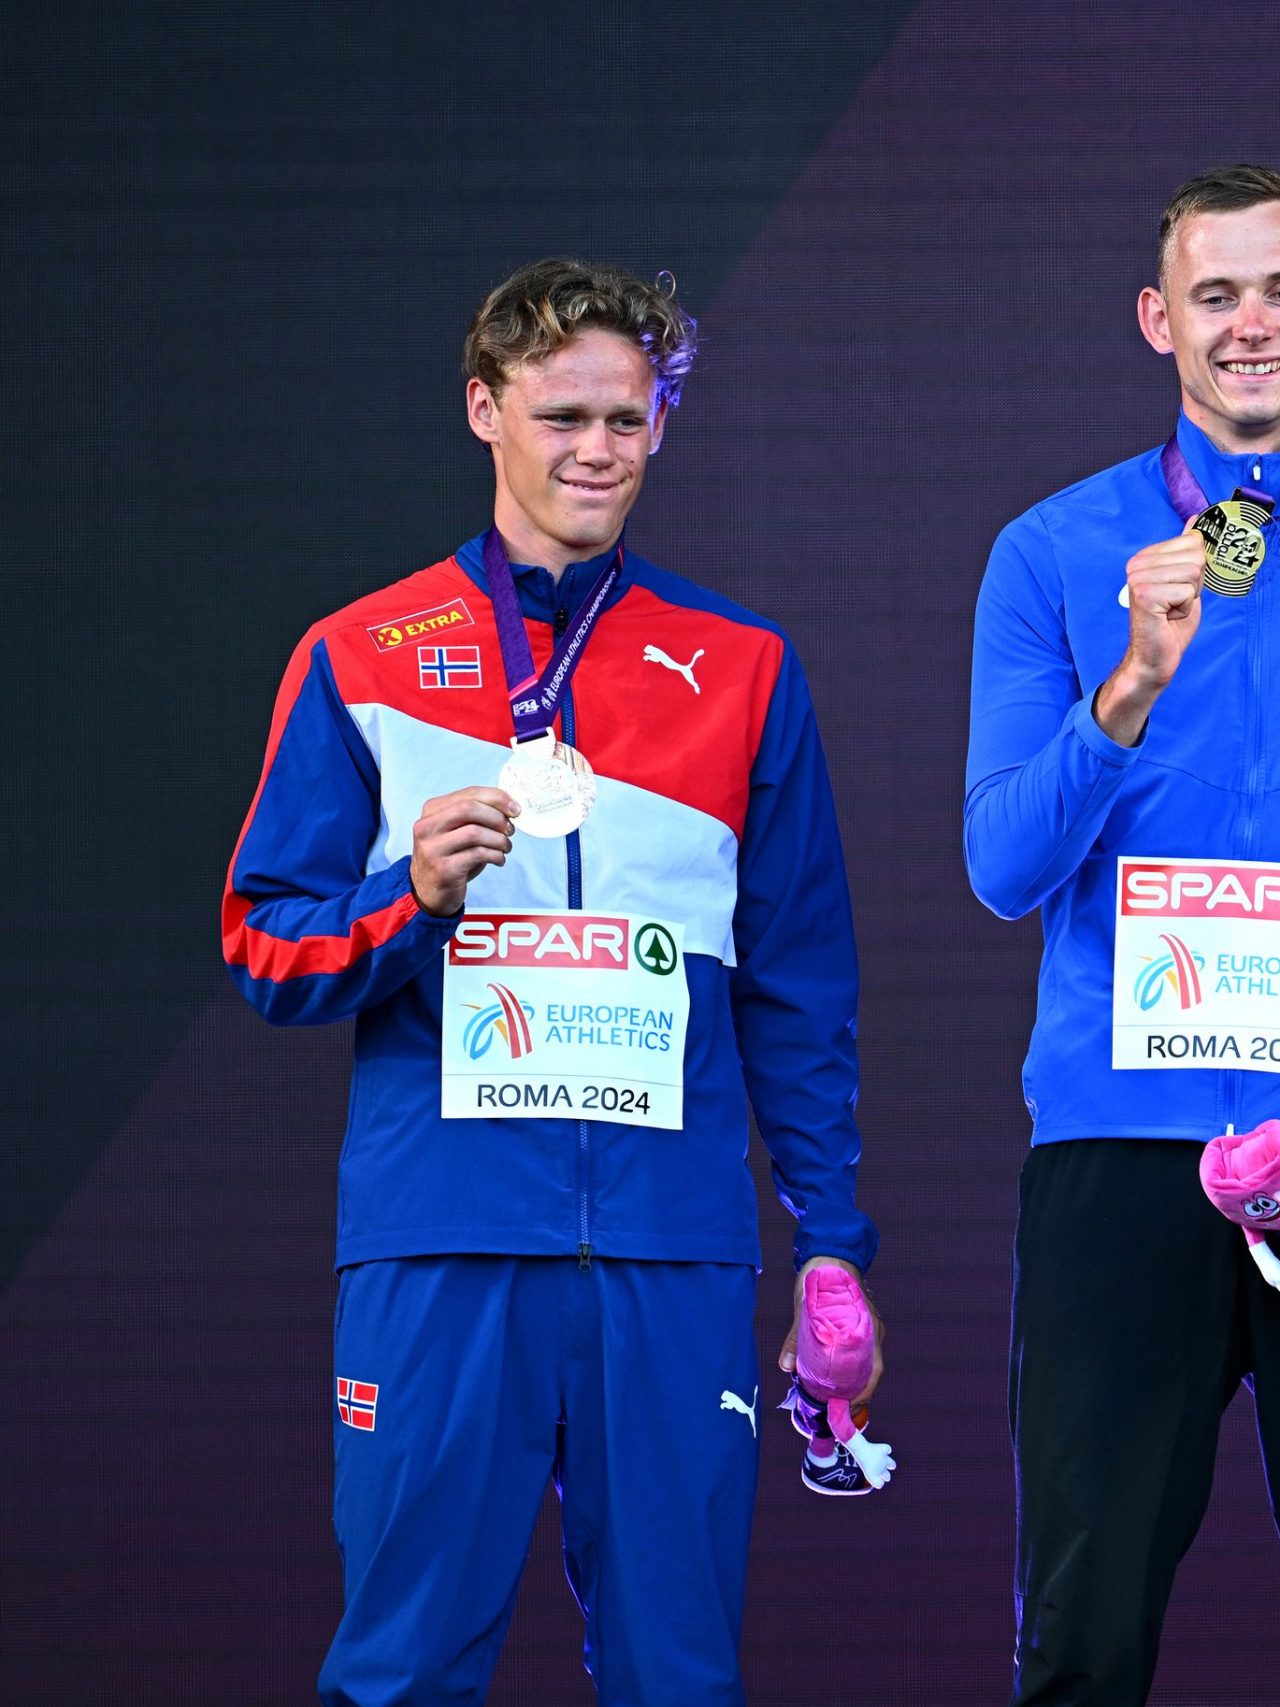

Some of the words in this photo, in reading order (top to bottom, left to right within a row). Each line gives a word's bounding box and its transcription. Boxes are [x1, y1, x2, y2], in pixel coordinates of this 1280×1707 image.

[1216, 523, 1236, 559] roma
[404, 610, 464, 636] EXTRA
[550, 656, 572, 692] EUROPEAN
[567, 620, 589, 659] ATHLETICS
[455, 921, 624, 962] SPAR
[547, 1004, 673, 1030] EUROPEAN
[545, 1026, 670, 1052] ATHLETICS
[1147, 1035, 1241, 1058] ROMA
[477, 1084, 573, 1108] ROMA
[582, 1086, 651, 1115] 2024
